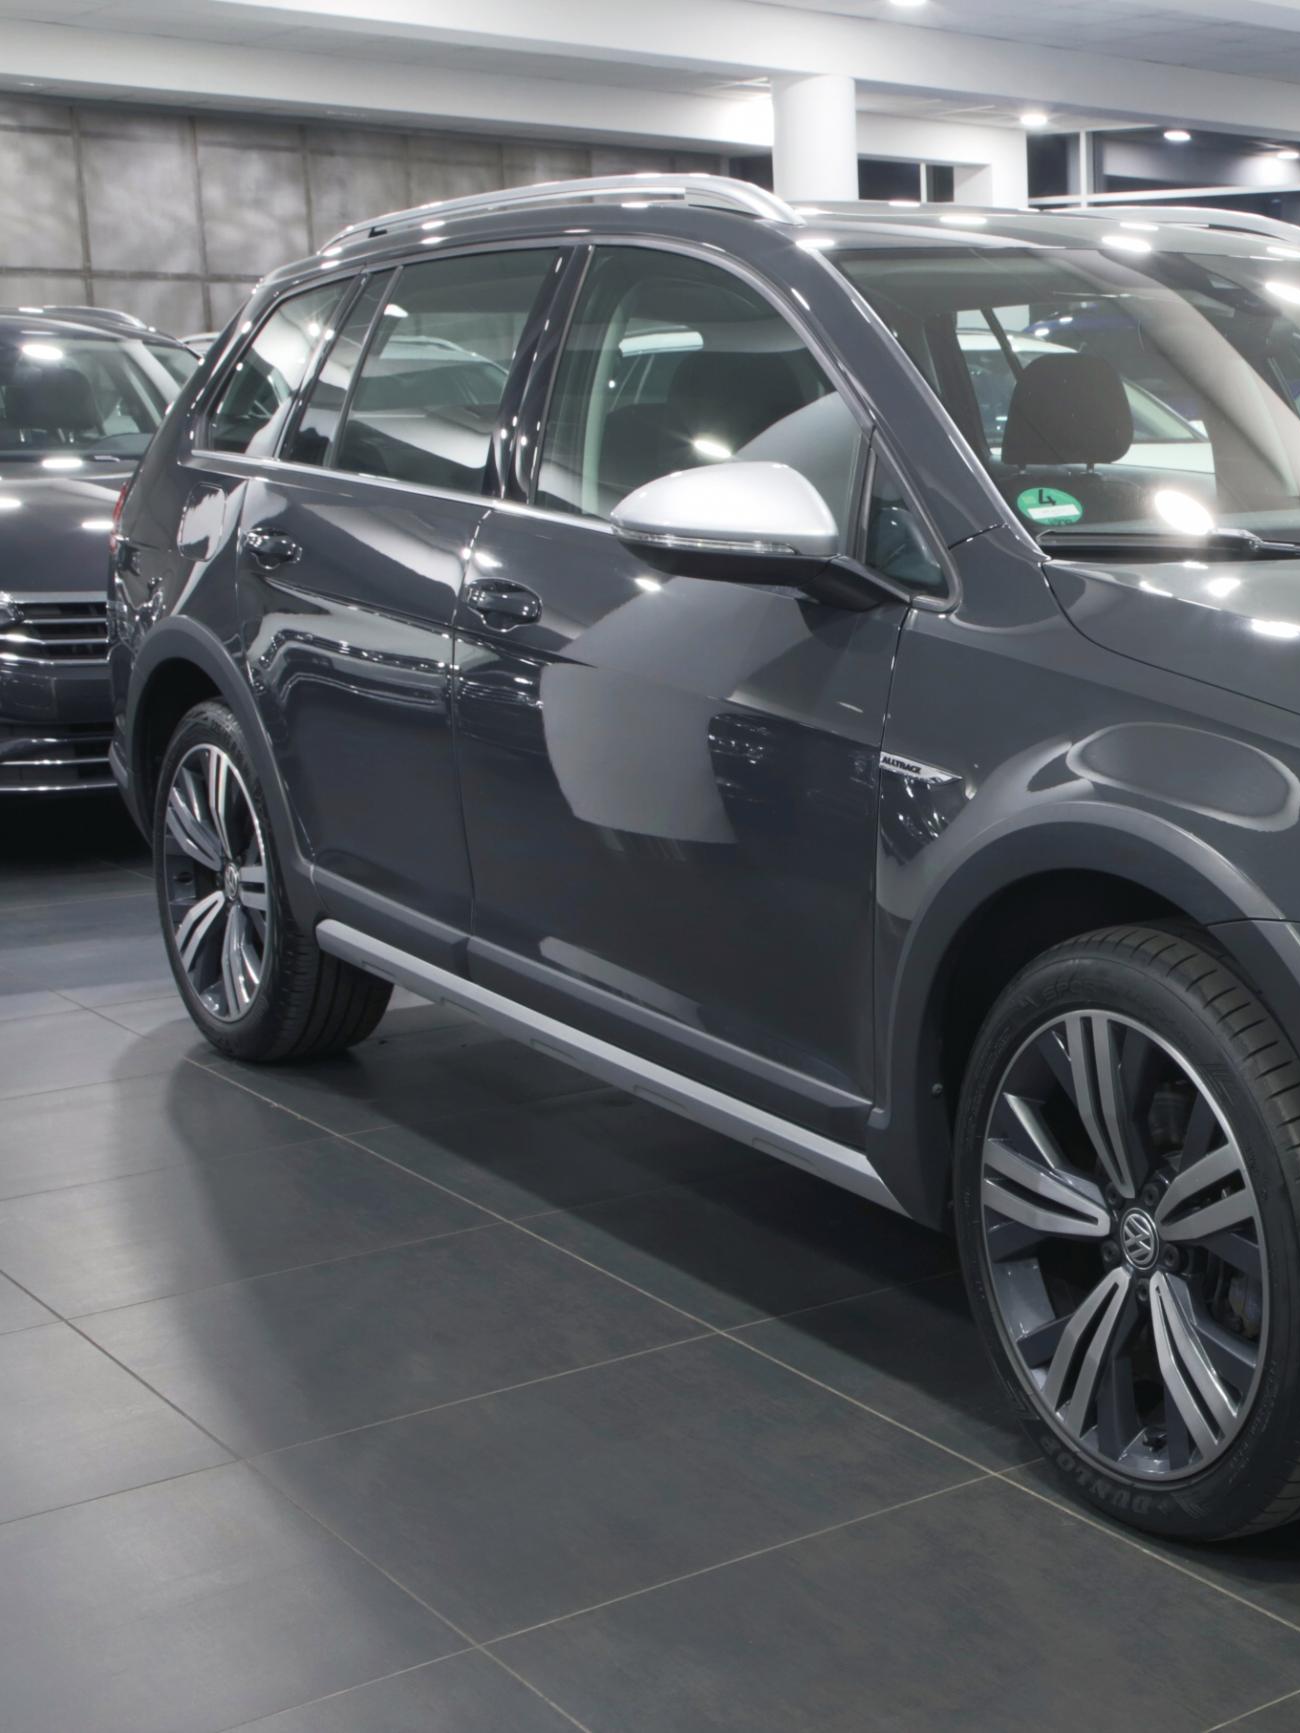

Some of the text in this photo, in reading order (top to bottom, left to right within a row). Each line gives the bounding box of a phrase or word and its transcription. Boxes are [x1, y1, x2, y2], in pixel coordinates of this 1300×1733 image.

[1038, 488, 1056, 506] 4
[882, 756, 921, 774] ALLTRACK
[1039, 1435, 1153, 1515] DUNLOP
